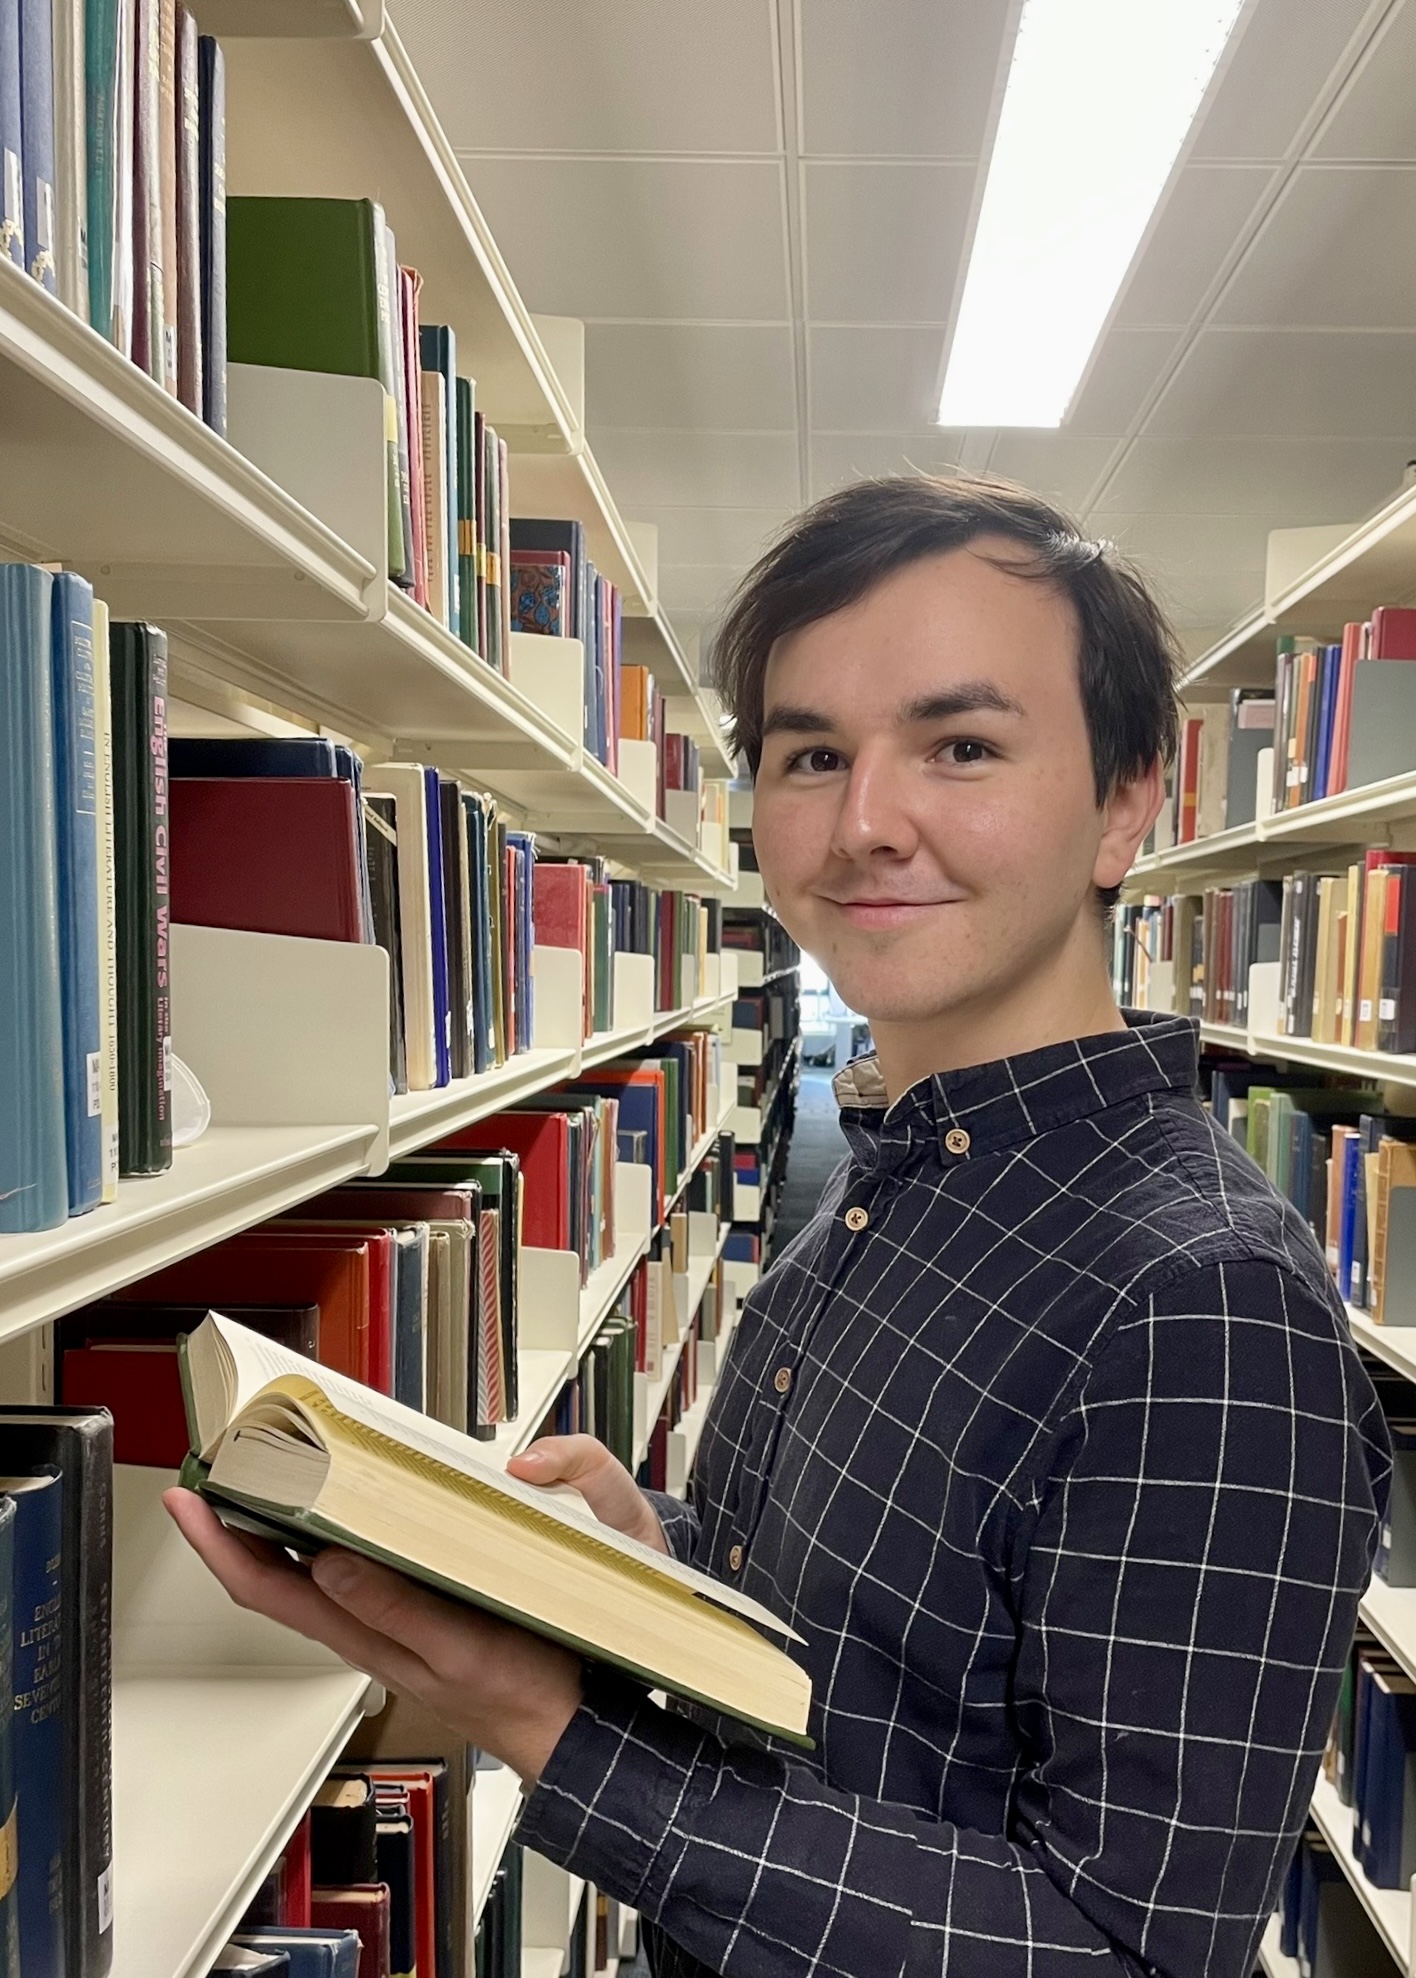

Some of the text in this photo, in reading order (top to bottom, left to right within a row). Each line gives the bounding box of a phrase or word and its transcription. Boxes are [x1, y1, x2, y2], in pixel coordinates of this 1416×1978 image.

[104, 732, 110, 748] IN
[150, 696, 168, 815] English
[104, 822, 113, 914] LITERATURE
[156, 905, 169, 988] Wars
[107, 958, 115, 1027] THOUGHT
[155, 997, 164, 1044] Literary
